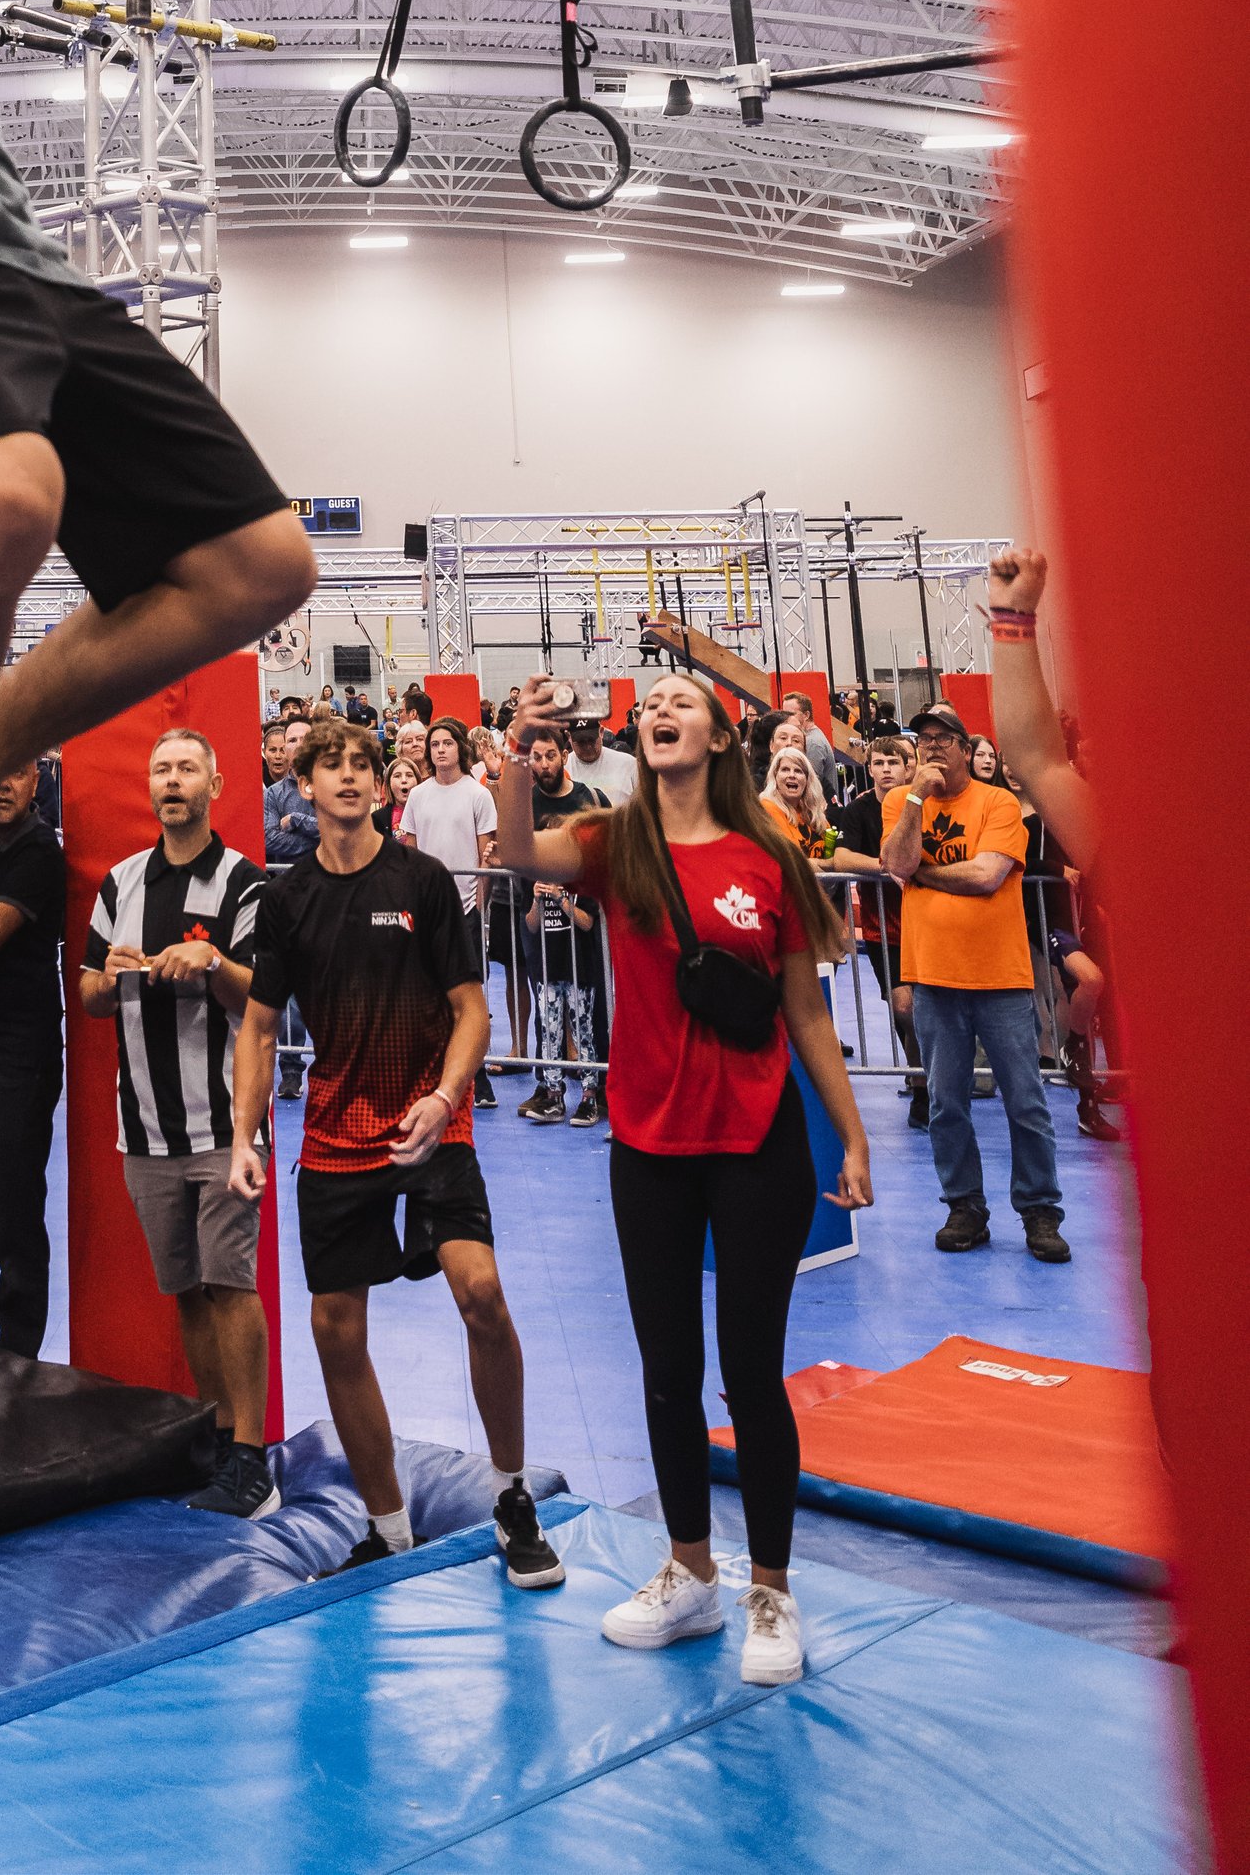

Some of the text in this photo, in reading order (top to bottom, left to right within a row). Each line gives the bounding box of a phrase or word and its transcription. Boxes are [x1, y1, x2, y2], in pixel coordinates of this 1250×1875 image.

[328, 499, 356, 508] GUEST
[371, 916, 398, 925] NINJA
[740, 910, 762, 930] CNL
